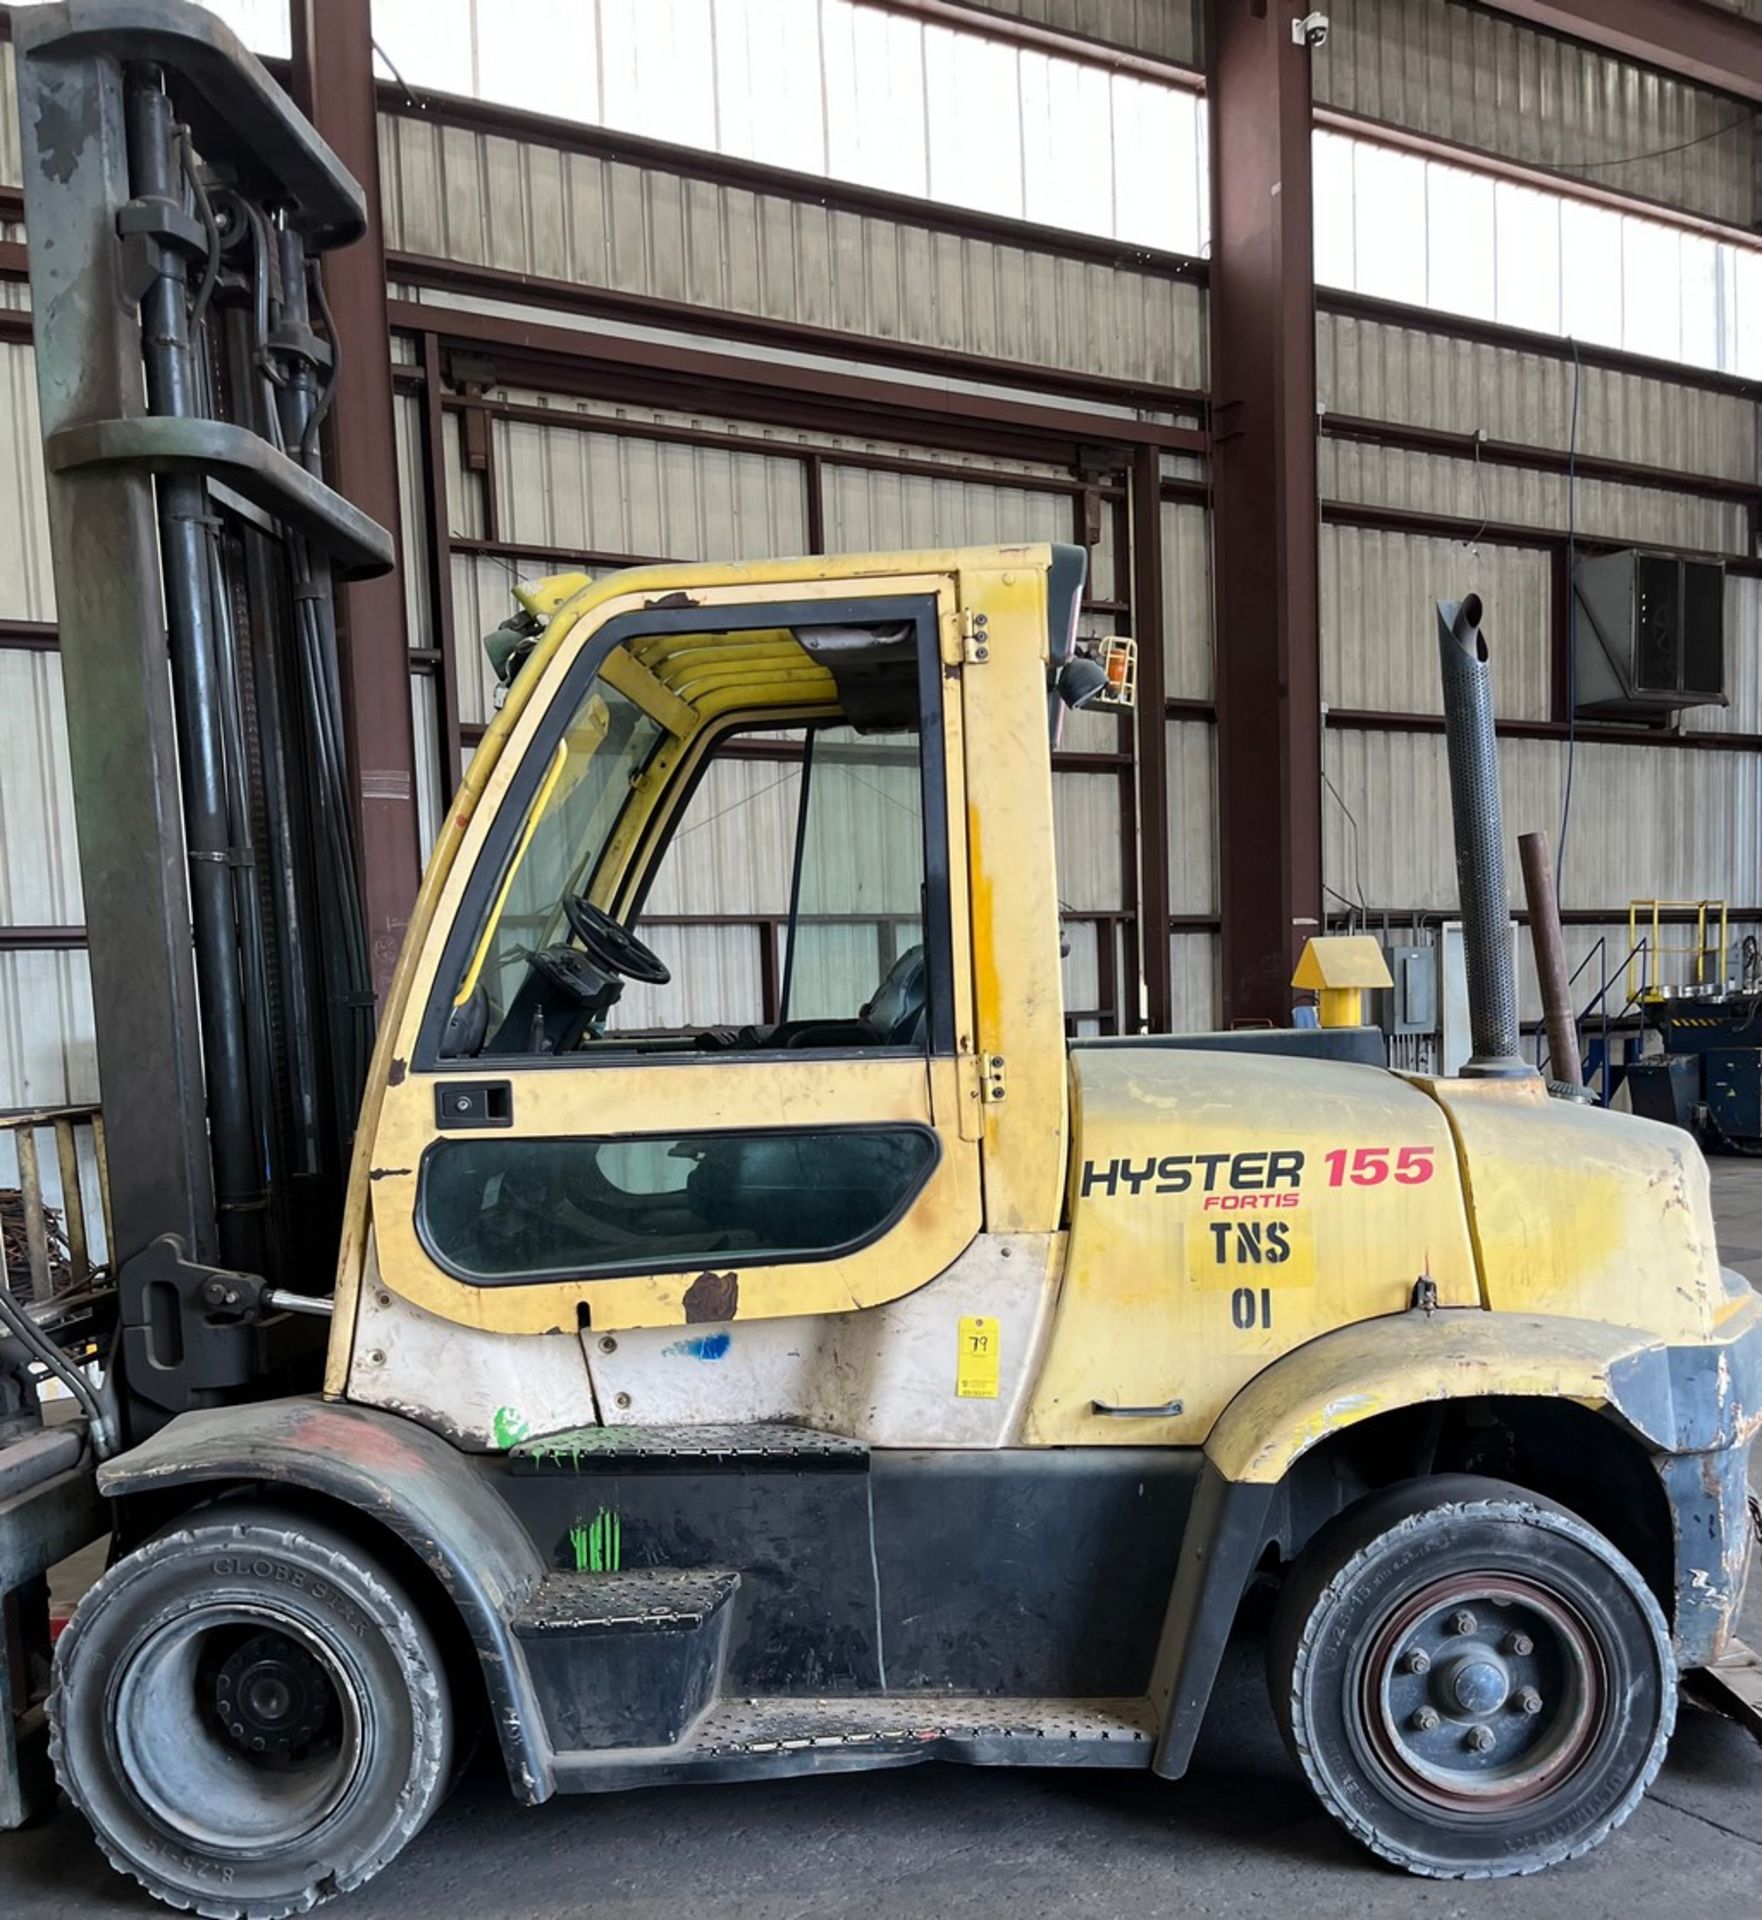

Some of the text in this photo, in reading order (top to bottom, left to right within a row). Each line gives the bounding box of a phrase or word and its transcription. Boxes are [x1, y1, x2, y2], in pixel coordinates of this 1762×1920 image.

[1081, 1146, 1435, 1197] HYSTER 155
[1203, 1193, 1300, 1211] FORTIS
[1209, 1222, 1291, 1263] TNS
[968, 1336, 988, 1352] 79
[212, 1557, 307, 1588] GLOBE
